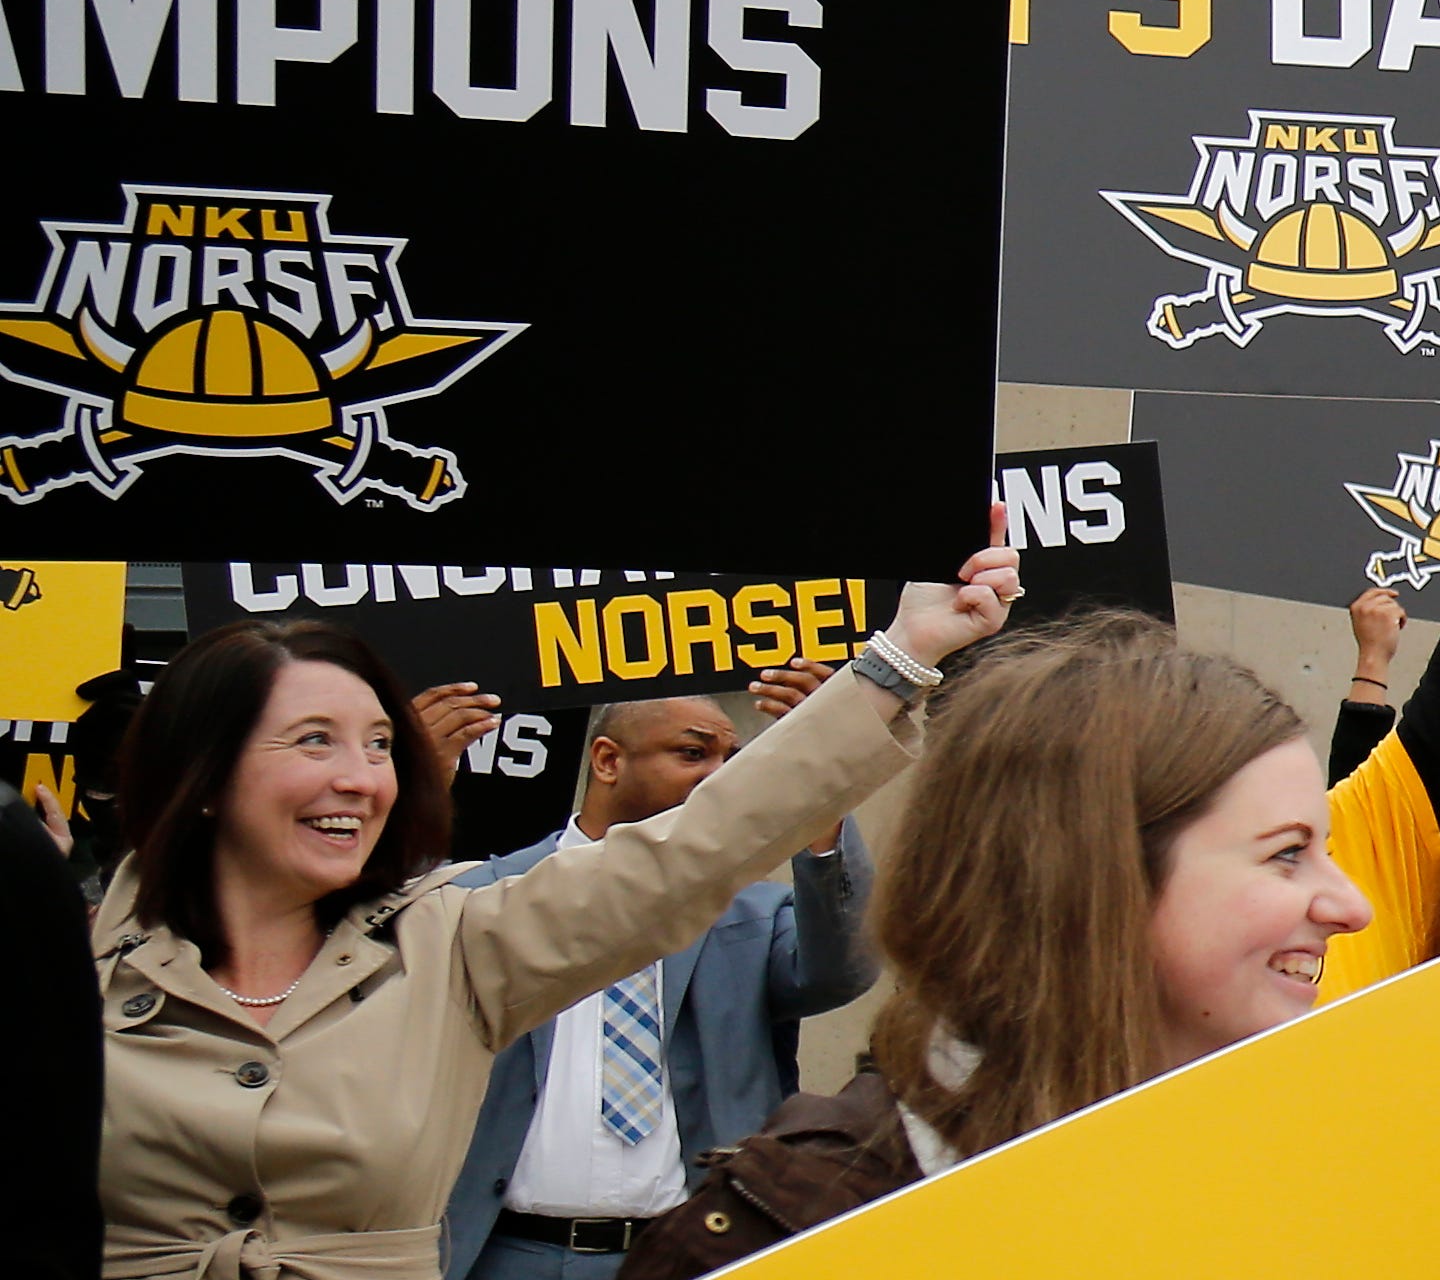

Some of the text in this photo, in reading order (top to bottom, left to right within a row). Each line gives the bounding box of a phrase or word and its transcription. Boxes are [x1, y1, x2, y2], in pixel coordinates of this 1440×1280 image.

[1264, 124, 1379, 155] NKU
[1202, 150, 1440, 227] NORSE
[146, 203, 309, 243] NKU
[56, 240, 395, 340] NORSE
[1420, 347, 1436, 357] TM
[364, 498, 385, 509] TM
[534, 578, 868, 688] NORSE!
